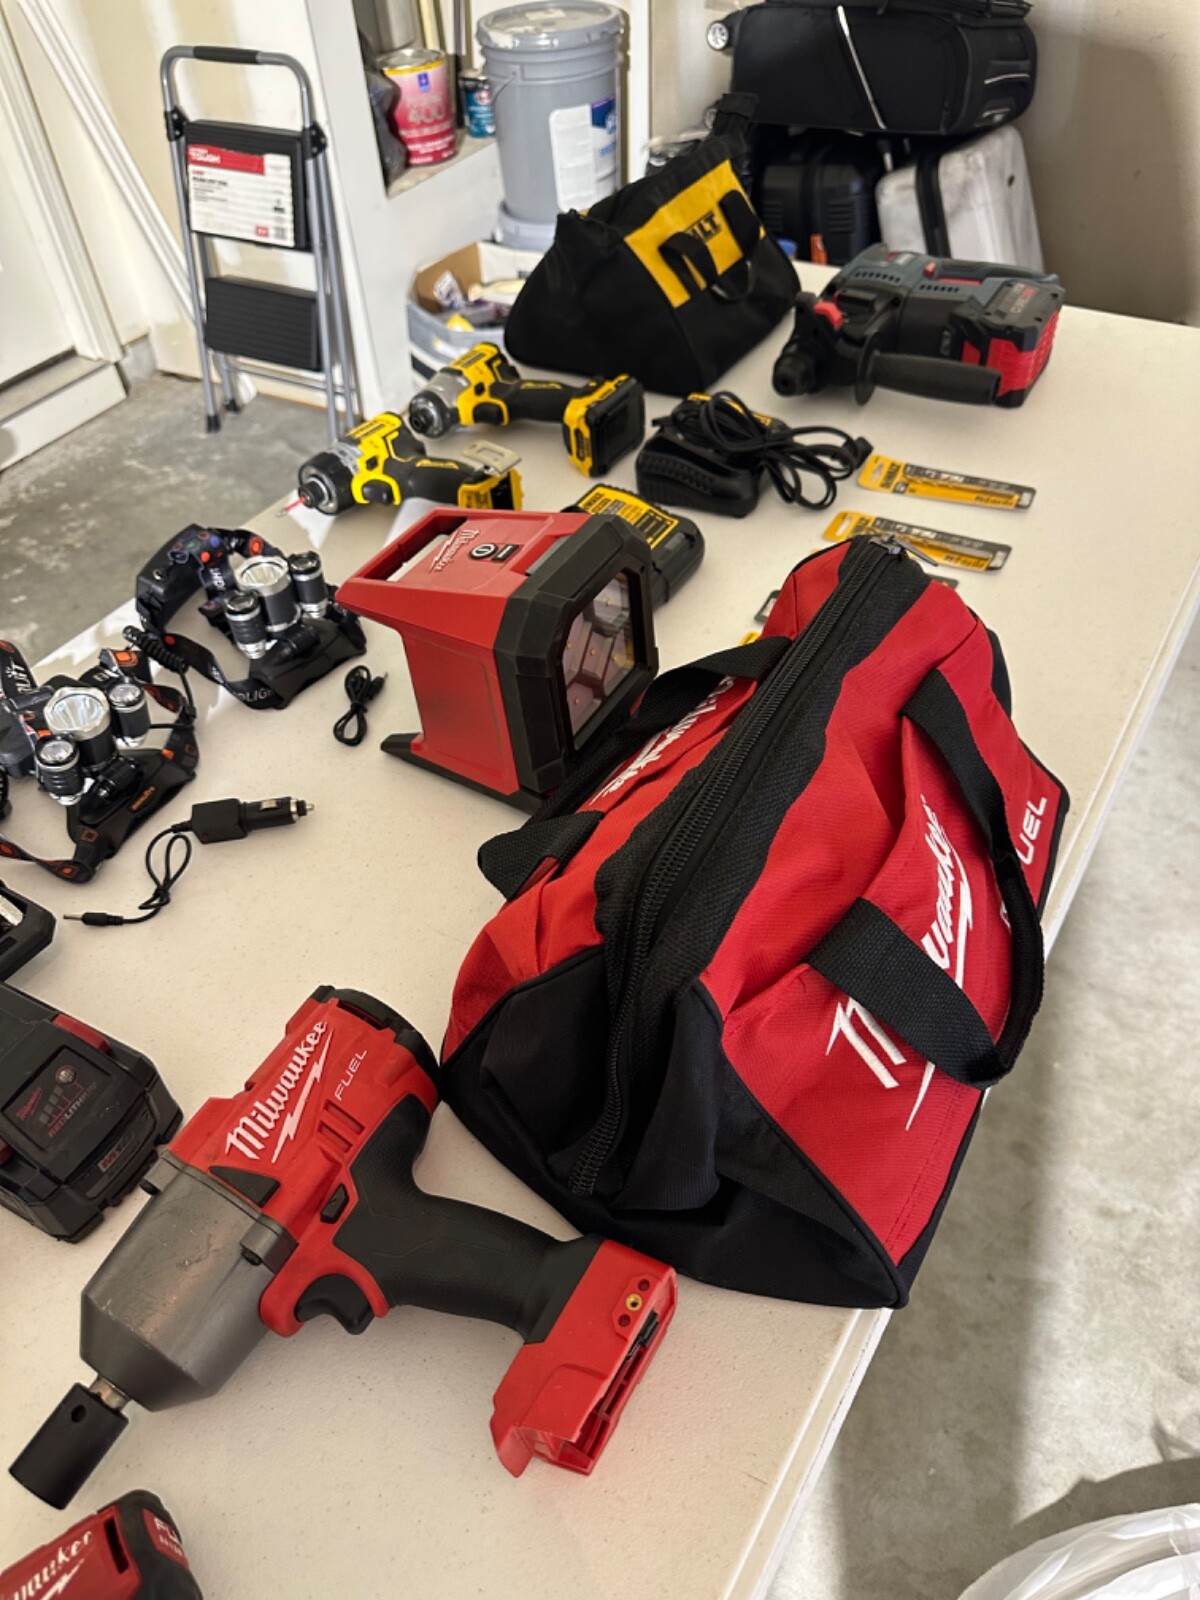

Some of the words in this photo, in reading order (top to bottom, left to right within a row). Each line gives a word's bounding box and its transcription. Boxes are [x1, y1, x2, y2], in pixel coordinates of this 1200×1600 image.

[1017, 797, 1048, 866] UEL
[224, 1020, 328, 1161] Milwaukee
[334, 1049, 368, 1102] FUEL
